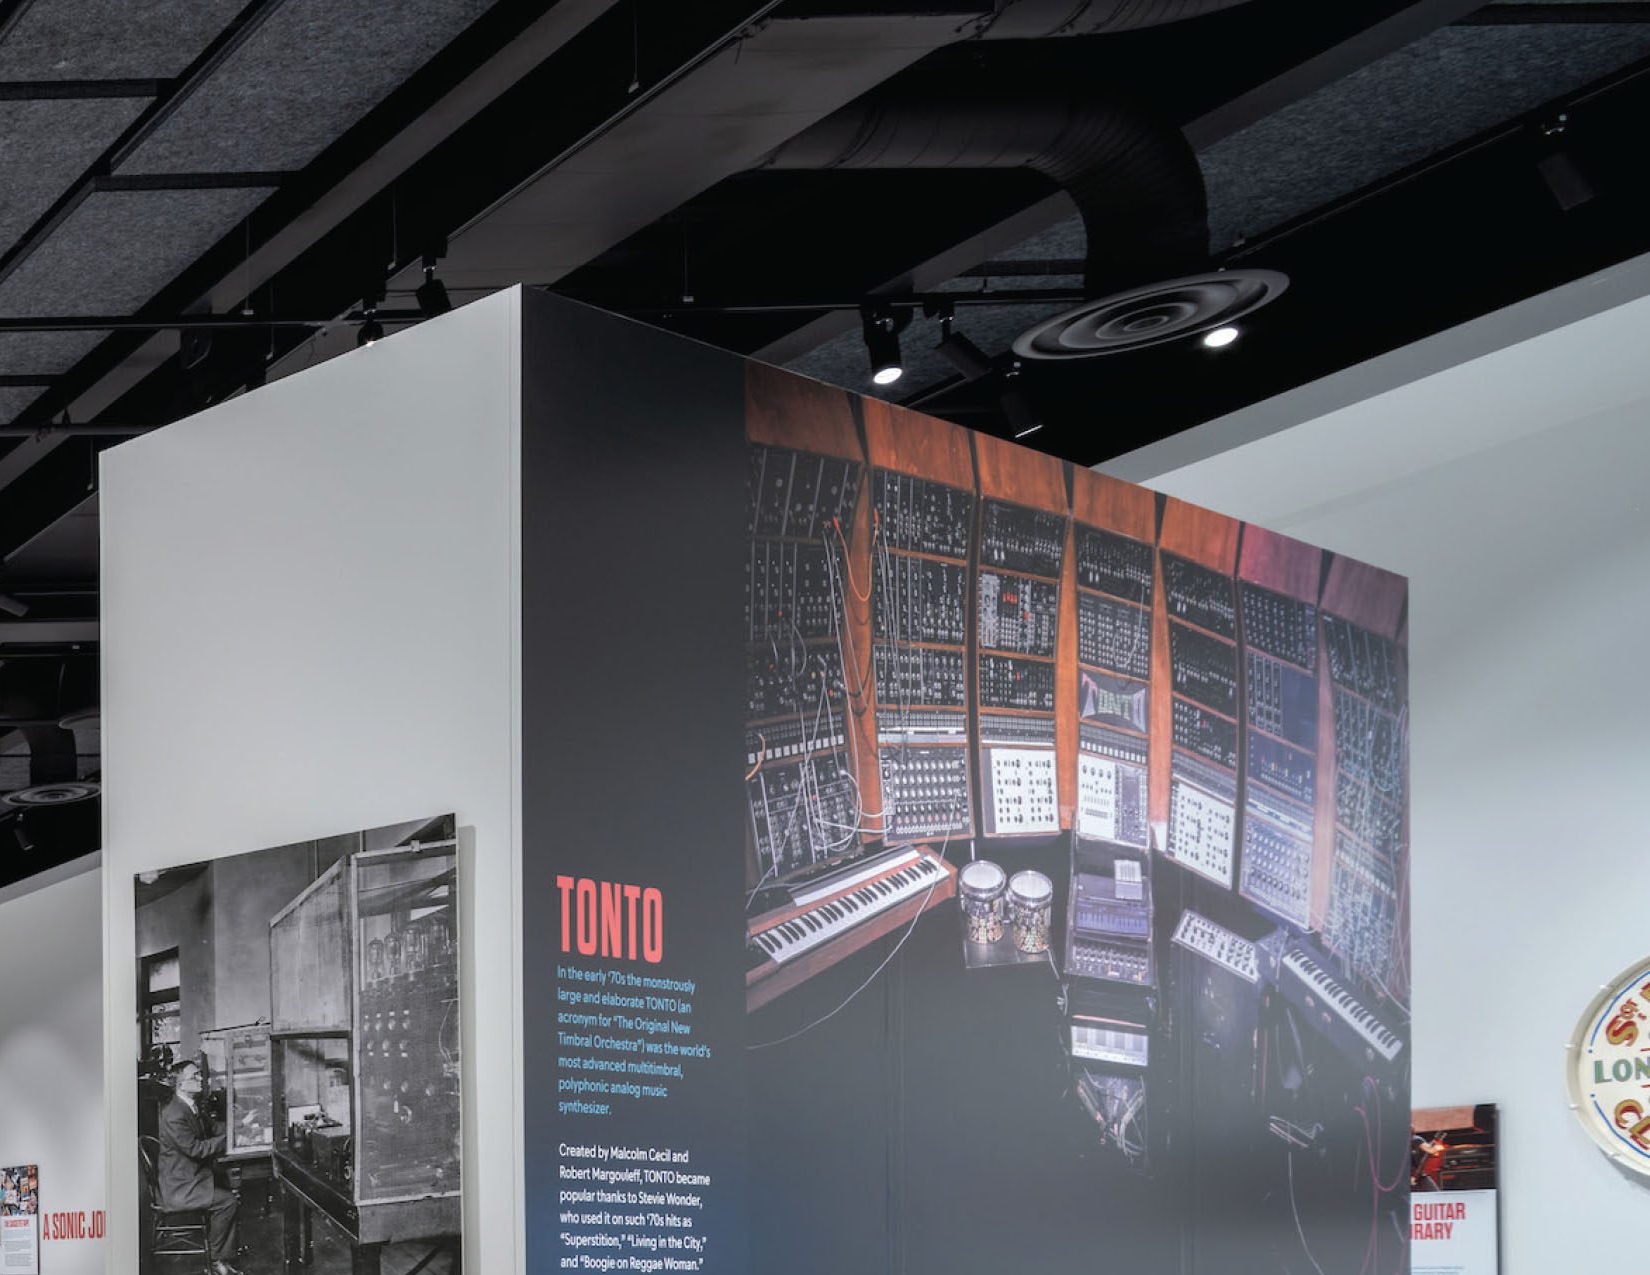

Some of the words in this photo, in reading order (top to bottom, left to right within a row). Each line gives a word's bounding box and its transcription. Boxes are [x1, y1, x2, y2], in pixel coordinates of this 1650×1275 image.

[557, 875, 663, 963] TONTO
[557, 966, 566, 980] In
[568, 967, 583, 982] the
[584, 968, 606, 987] early
[627, 973, 641, 987] the
[643, 974, 695, 996] monstrously
[558, 988, 581, 1007] large
[582, 990, 600, 1005] and
[602, 992, 644, 1009] elaborate
[646, 996, 676, 1011] TONTO
[678, 999, 692, 1014] (an
[558, 1013, 597, 1030] acronym
[599, 1013, 611, 1028] for
[634, 1016, 670, 1036] Original
[671, 1020, 691, 1034] New
[559, 1032, 592, 1048] Timbral
[646, 1042, 662, 1053] was
[664, 1040, 678, 1054] the
[558, 1076, 609, 1096] polyphonic
[610, 1080, 640, 1098] analog
[642, 1082, 668, 1097] music
[558, 1098, 611, 1118] synthesizer.
[559, 1143, 596, 1159] Created
[598, 1145, 608, 1163] by
[610, 1146, 647, 1161] Malcolm
[648, 1148, 671, 1162] Cecil
[672, 1149, 689, 1163] and
[560, 1165, 590, 1180] Robert
[592, 1167, 643, 1185] Margouleff,
[644, 1169, 675, 1183] TONTO
[676, 1170, 710, 1184] became
[560, 1188, 595, 1205] popular
[596, 1189, 626, 1203] thanks
[627, 1192, 637, 1203] to
[638, 1191, 665, 1204] Stevie
[666, 1192, 703, 1207] Wonder,
[1413, 1202, 1465, 1221] GUITAR
[43, 1213, 51, 1240] A
[52, 1211, 86, 1240] SONIC
[88, 1210, 107, 1239] JO
[658, 1235, 666, 1247] in
[668, 1235, 682, 1248] the
[561, 1255, 578, 1268] and
[616, 1259, 628, 1269] on
[630, 1256, 663, 1273] Reggae
